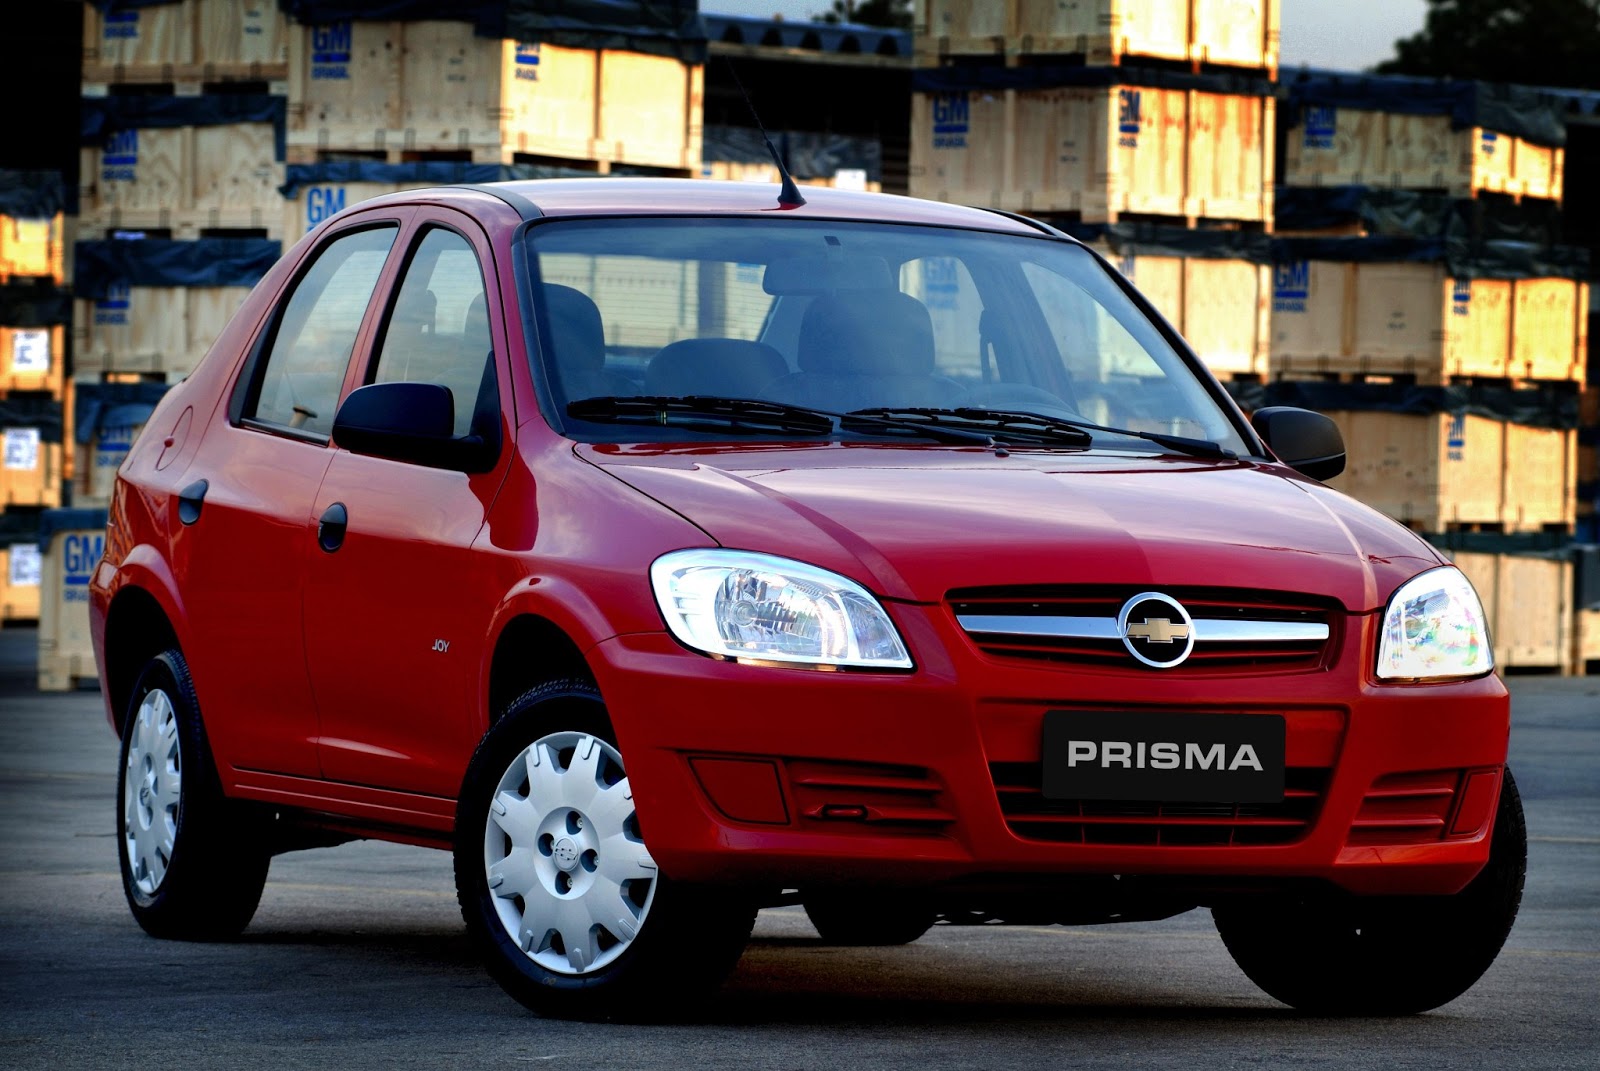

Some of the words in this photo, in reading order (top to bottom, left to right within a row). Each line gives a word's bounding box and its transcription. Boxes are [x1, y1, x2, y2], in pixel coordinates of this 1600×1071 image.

[934, 93, 969, 123] GM
[307, 187, 346, 224] GM
[1275, 261, 1309, 288] GM
[64, 534, 105, 573] GM
[431, 638, 450, 653] JOY
[1067, 740, 1264, 771] PRISMA
